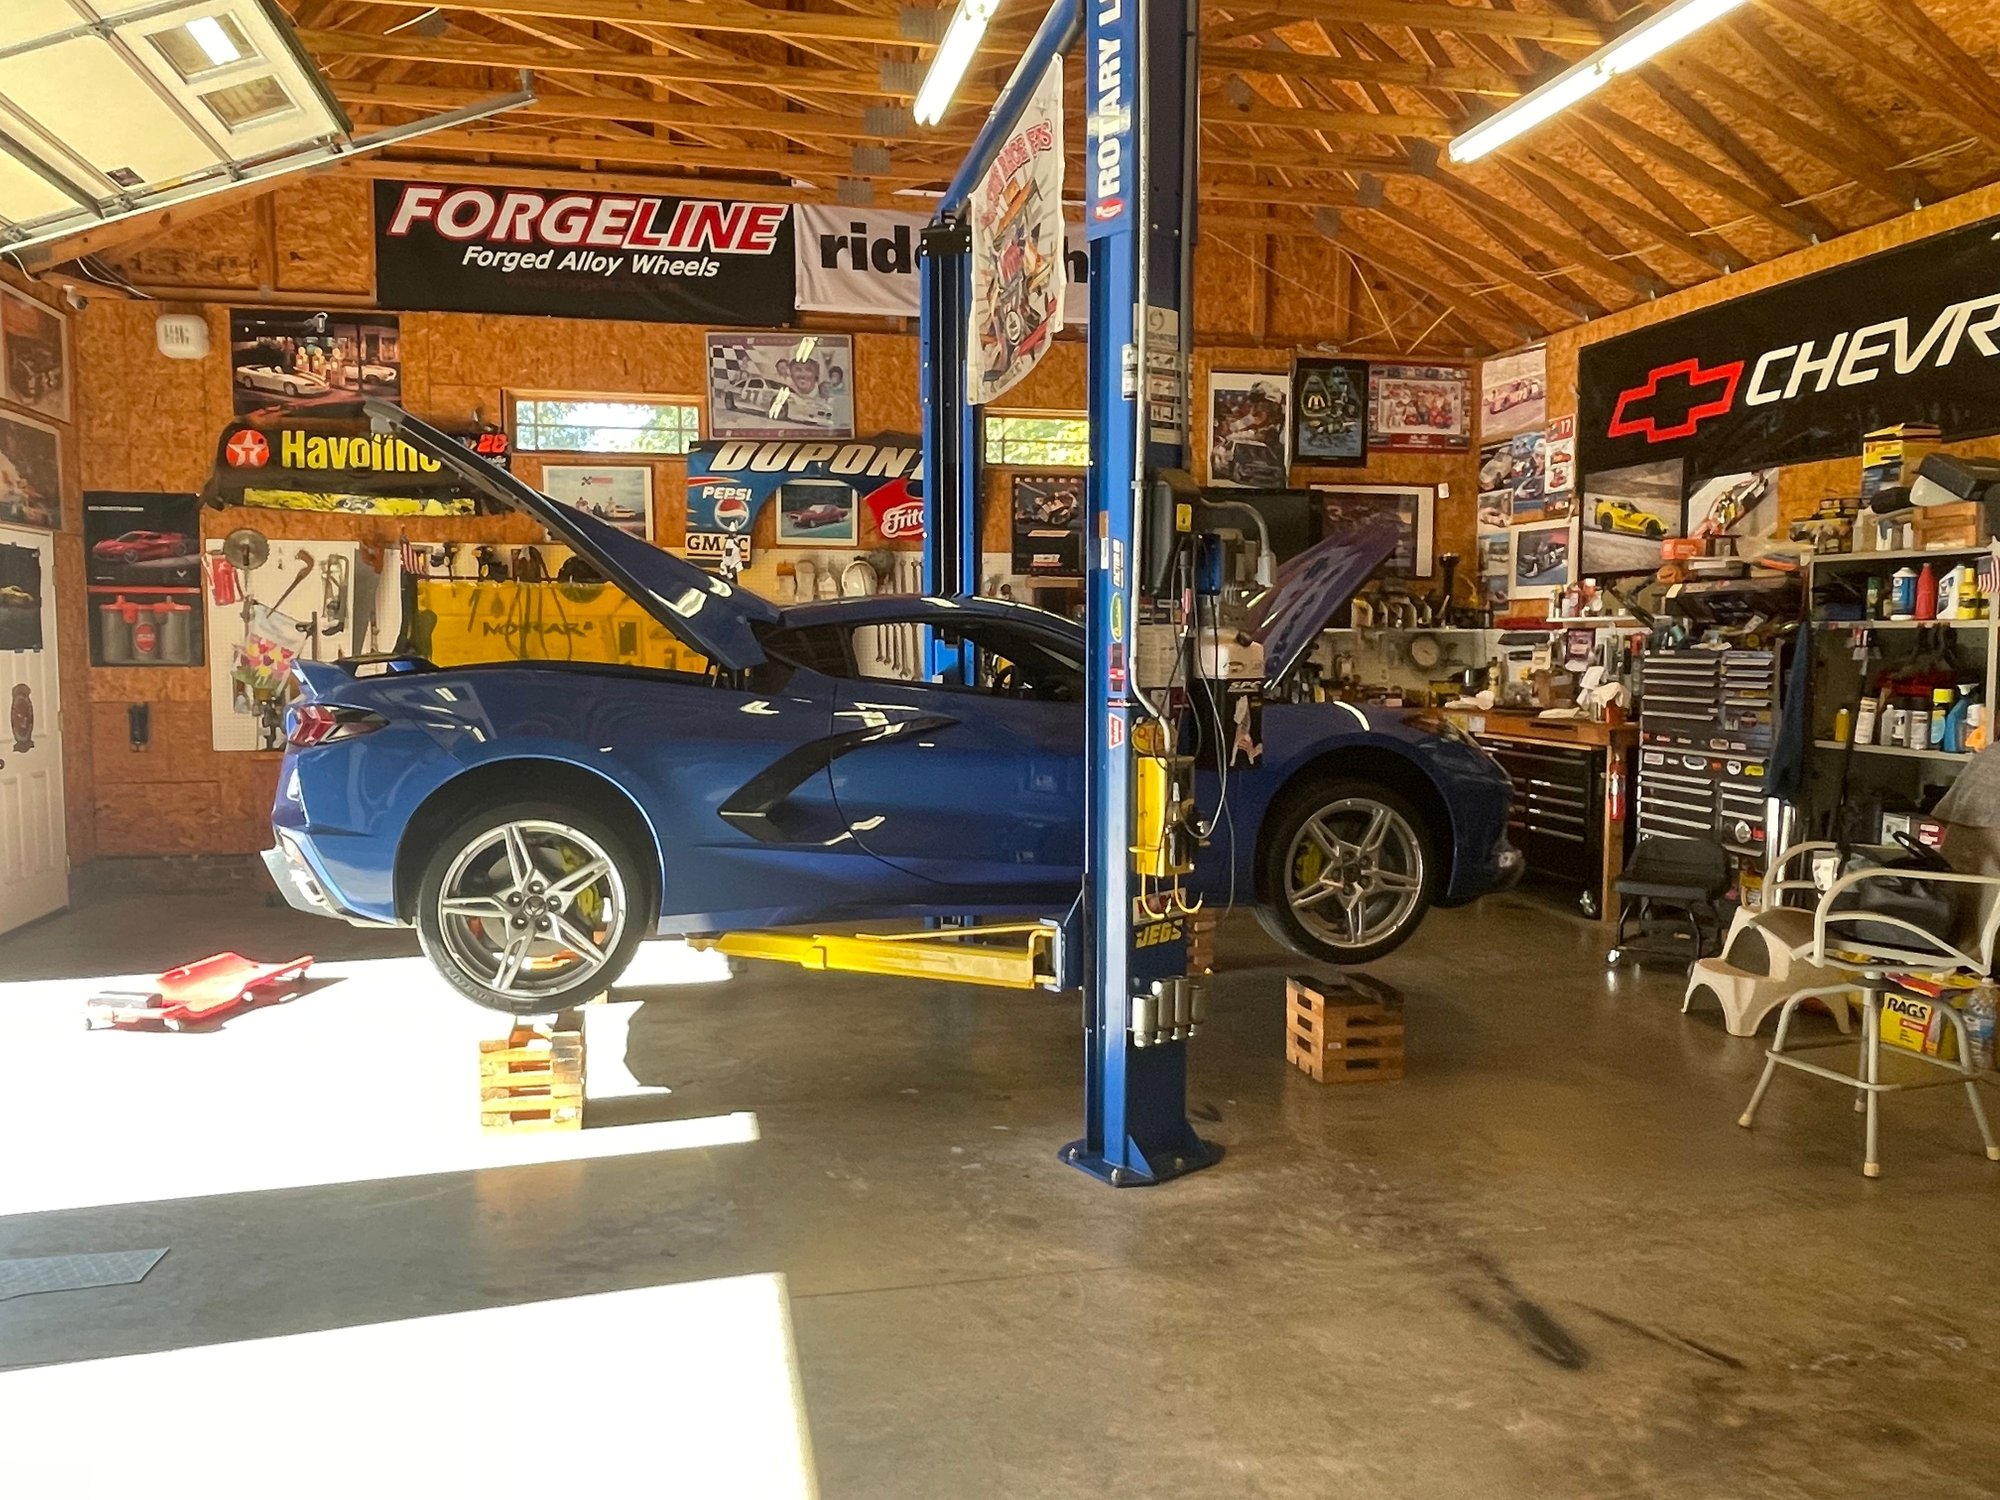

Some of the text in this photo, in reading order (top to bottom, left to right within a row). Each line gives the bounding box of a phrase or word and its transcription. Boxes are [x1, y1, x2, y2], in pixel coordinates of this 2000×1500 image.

[1098, 0, 1121, 199] ROTARY L
[387, 184, 789, 255] FORGELINE
[462, 246, 721, 278] Forged Alloy Wheels
[702, 486, 753, 502] PEPSI
[687, 535, 748, 552] GMC
[1136, 920, 1183, 947] JEGS
[1887, 997, 1928, 1020] RAGS
